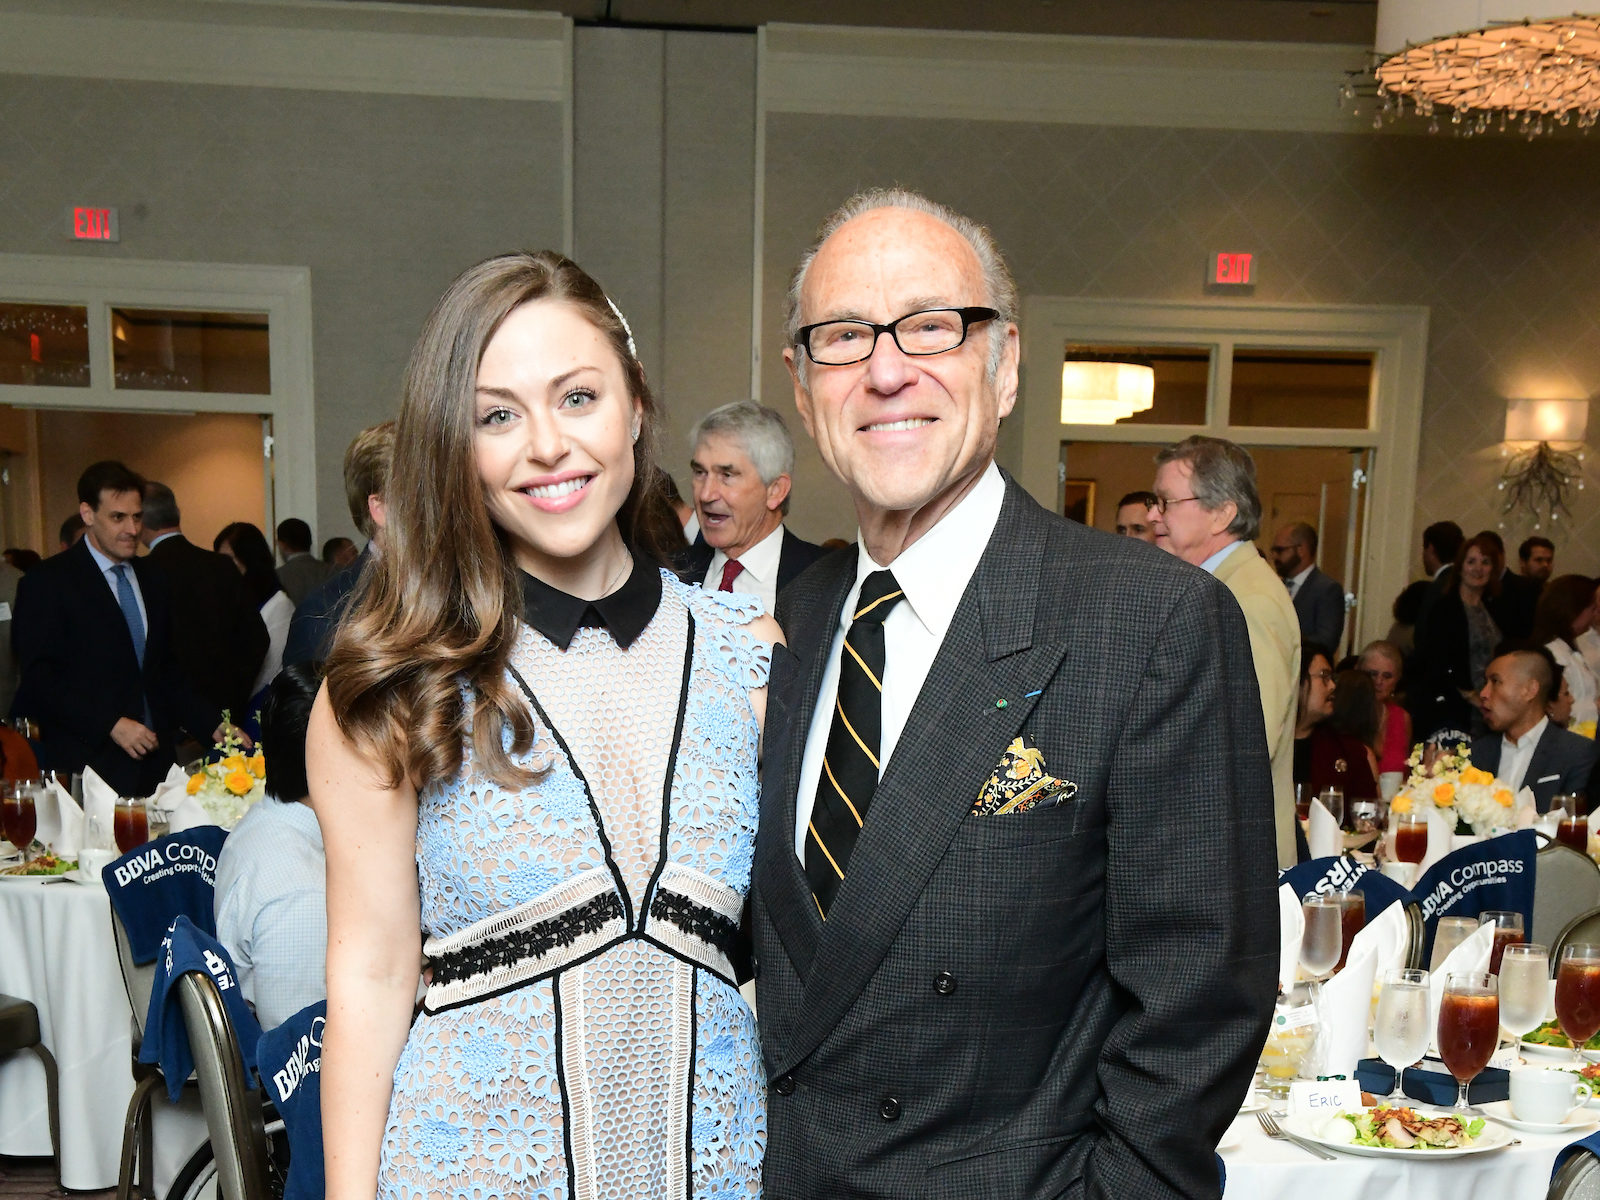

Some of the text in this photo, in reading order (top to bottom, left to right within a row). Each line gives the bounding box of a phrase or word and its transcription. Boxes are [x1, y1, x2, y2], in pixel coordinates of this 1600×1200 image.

[74, 207, 110, 239] EXIT
[1216, 253, 1253, 284] EXIT
[114, 842, 217, 888] BBVA Comp
[143, 867, 175, 885] Creating
[1450, 859, 1524, 887] Compass
[1309, 1093, 1342, 1108] ERIC
